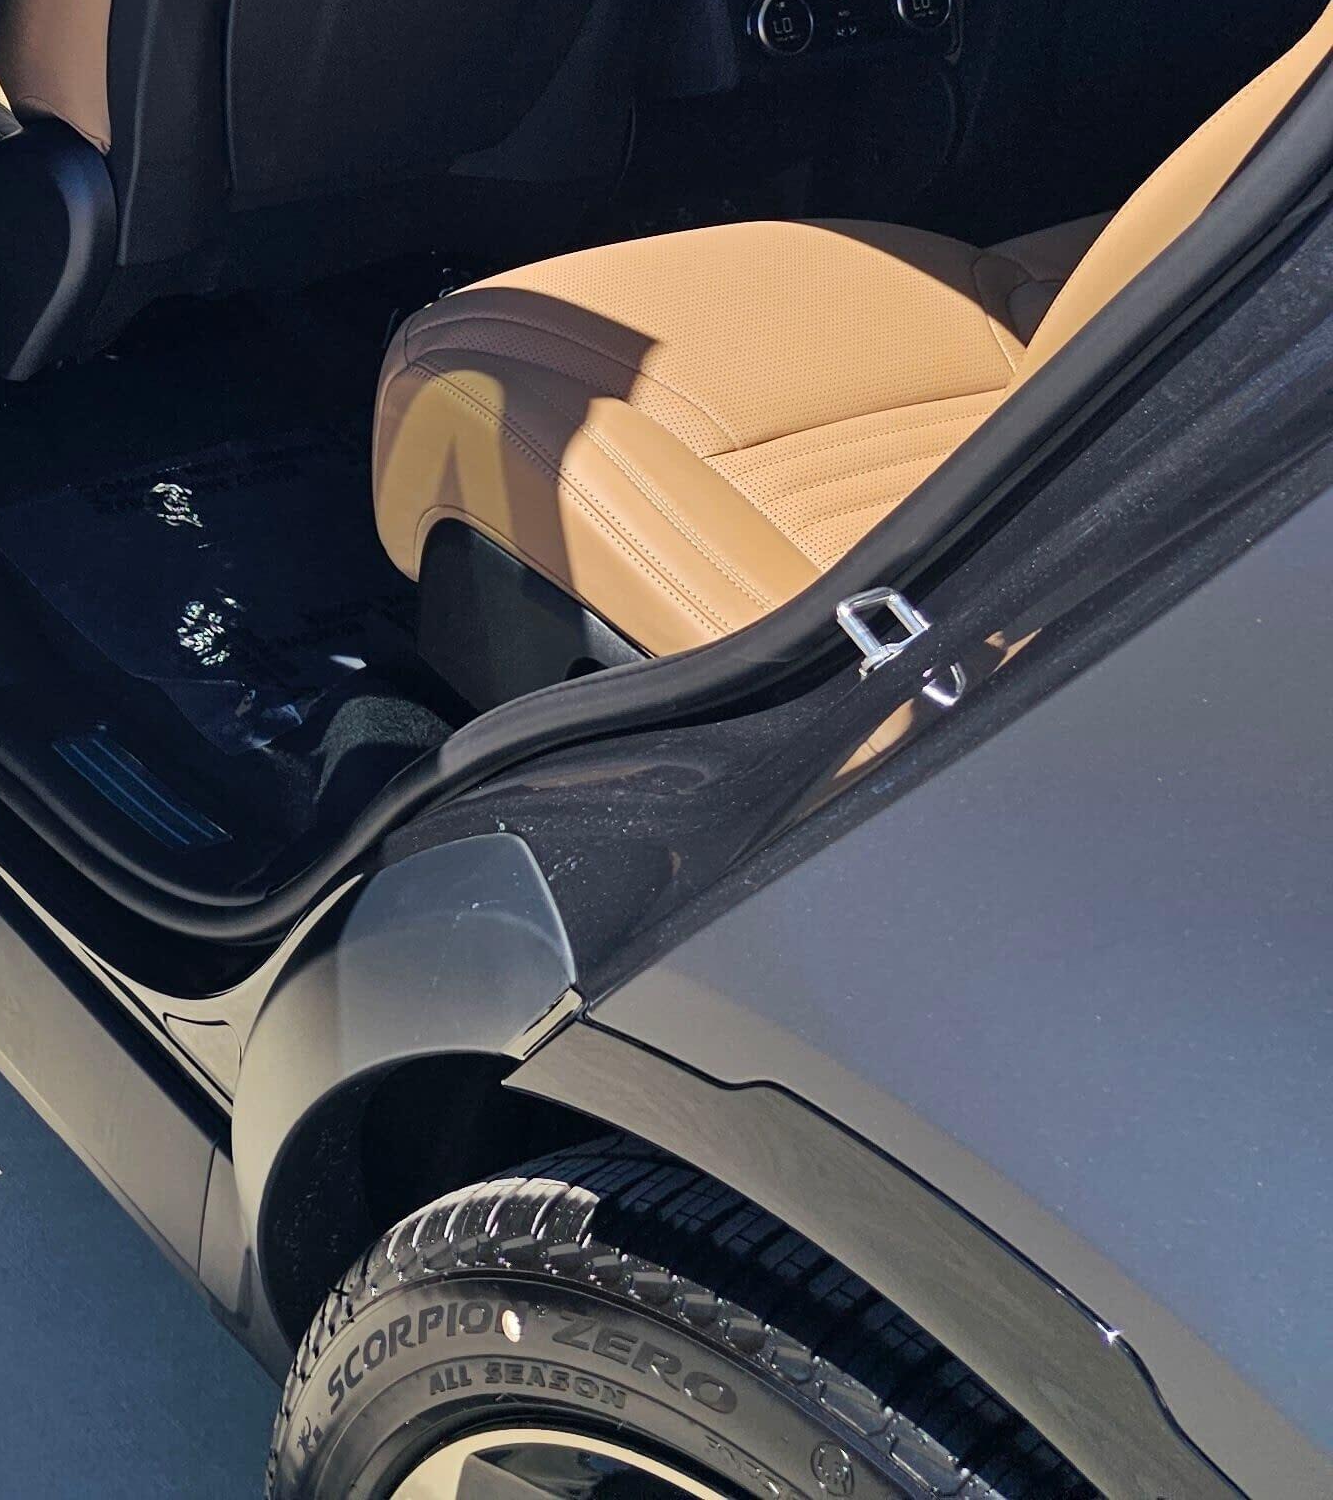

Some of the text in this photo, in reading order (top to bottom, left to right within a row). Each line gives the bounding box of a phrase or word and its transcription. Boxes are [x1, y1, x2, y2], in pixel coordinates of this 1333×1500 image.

[327, 1300, 737, 1415] SCORPION ZERO
[429, 1361, 628, 1410] ALL SEASON
